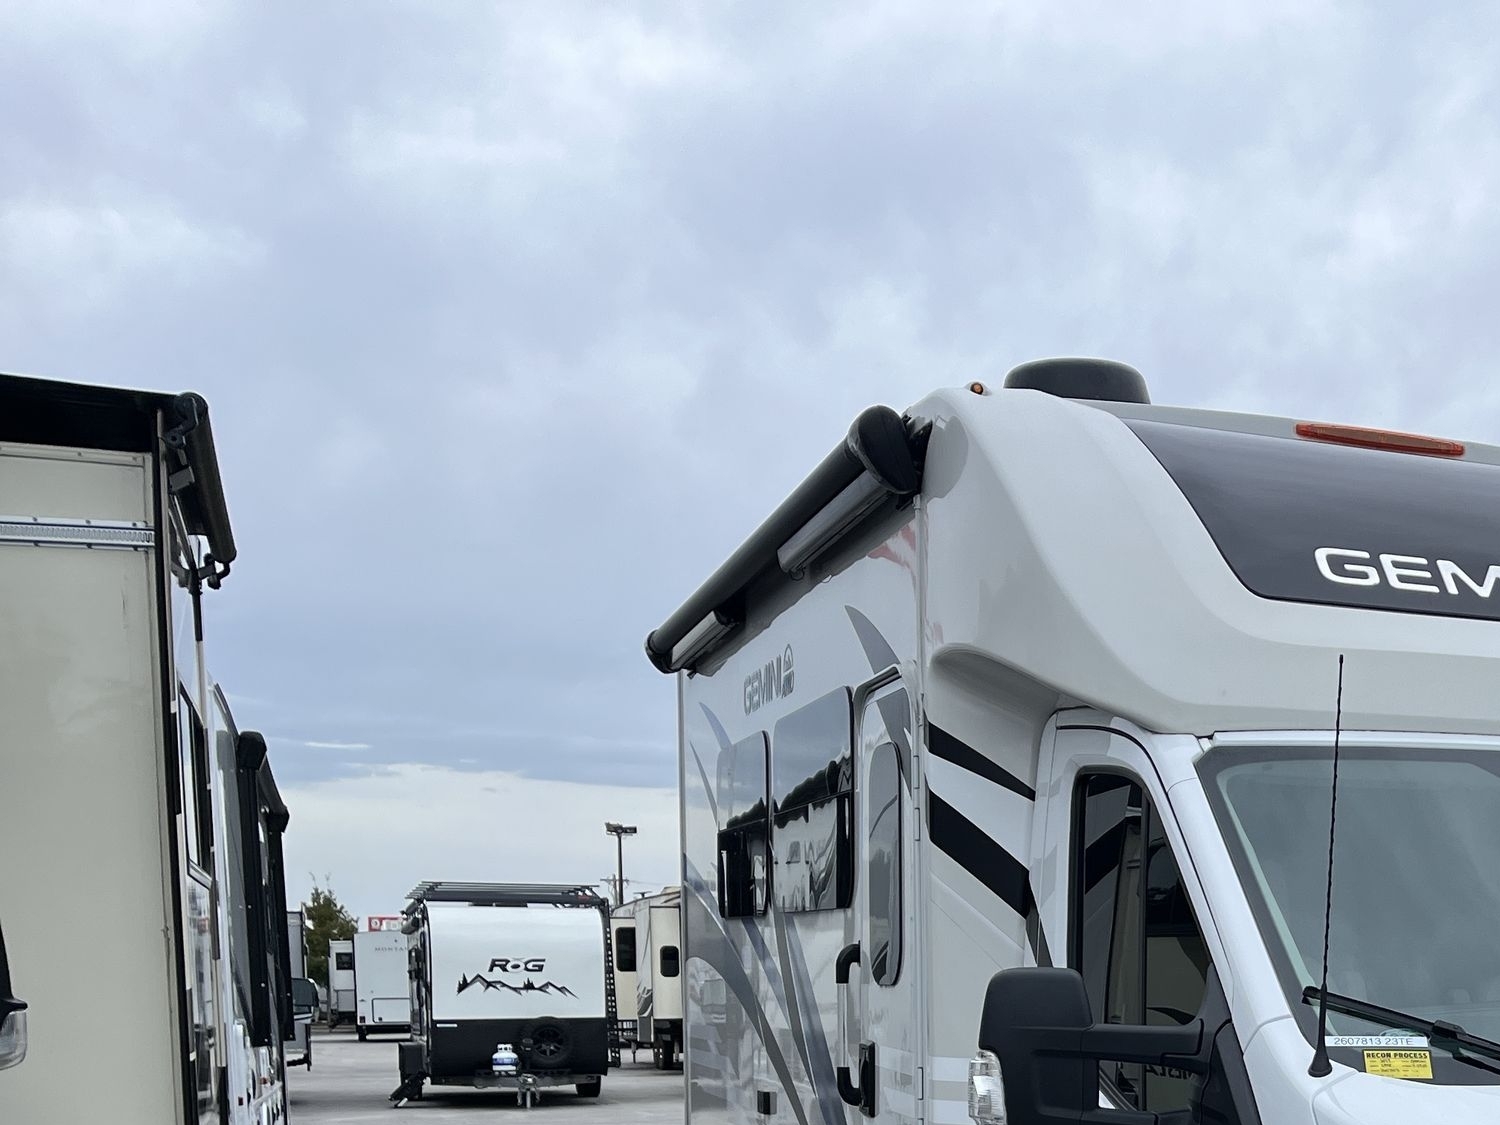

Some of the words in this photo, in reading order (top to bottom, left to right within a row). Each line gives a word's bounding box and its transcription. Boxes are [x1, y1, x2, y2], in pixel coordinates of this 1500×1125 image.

[744, 654, 782, 716] GEMINI
[1333, 1037, 1382, 1046] 2607813
[1385, 1037, 1414, 1046] 23TE
